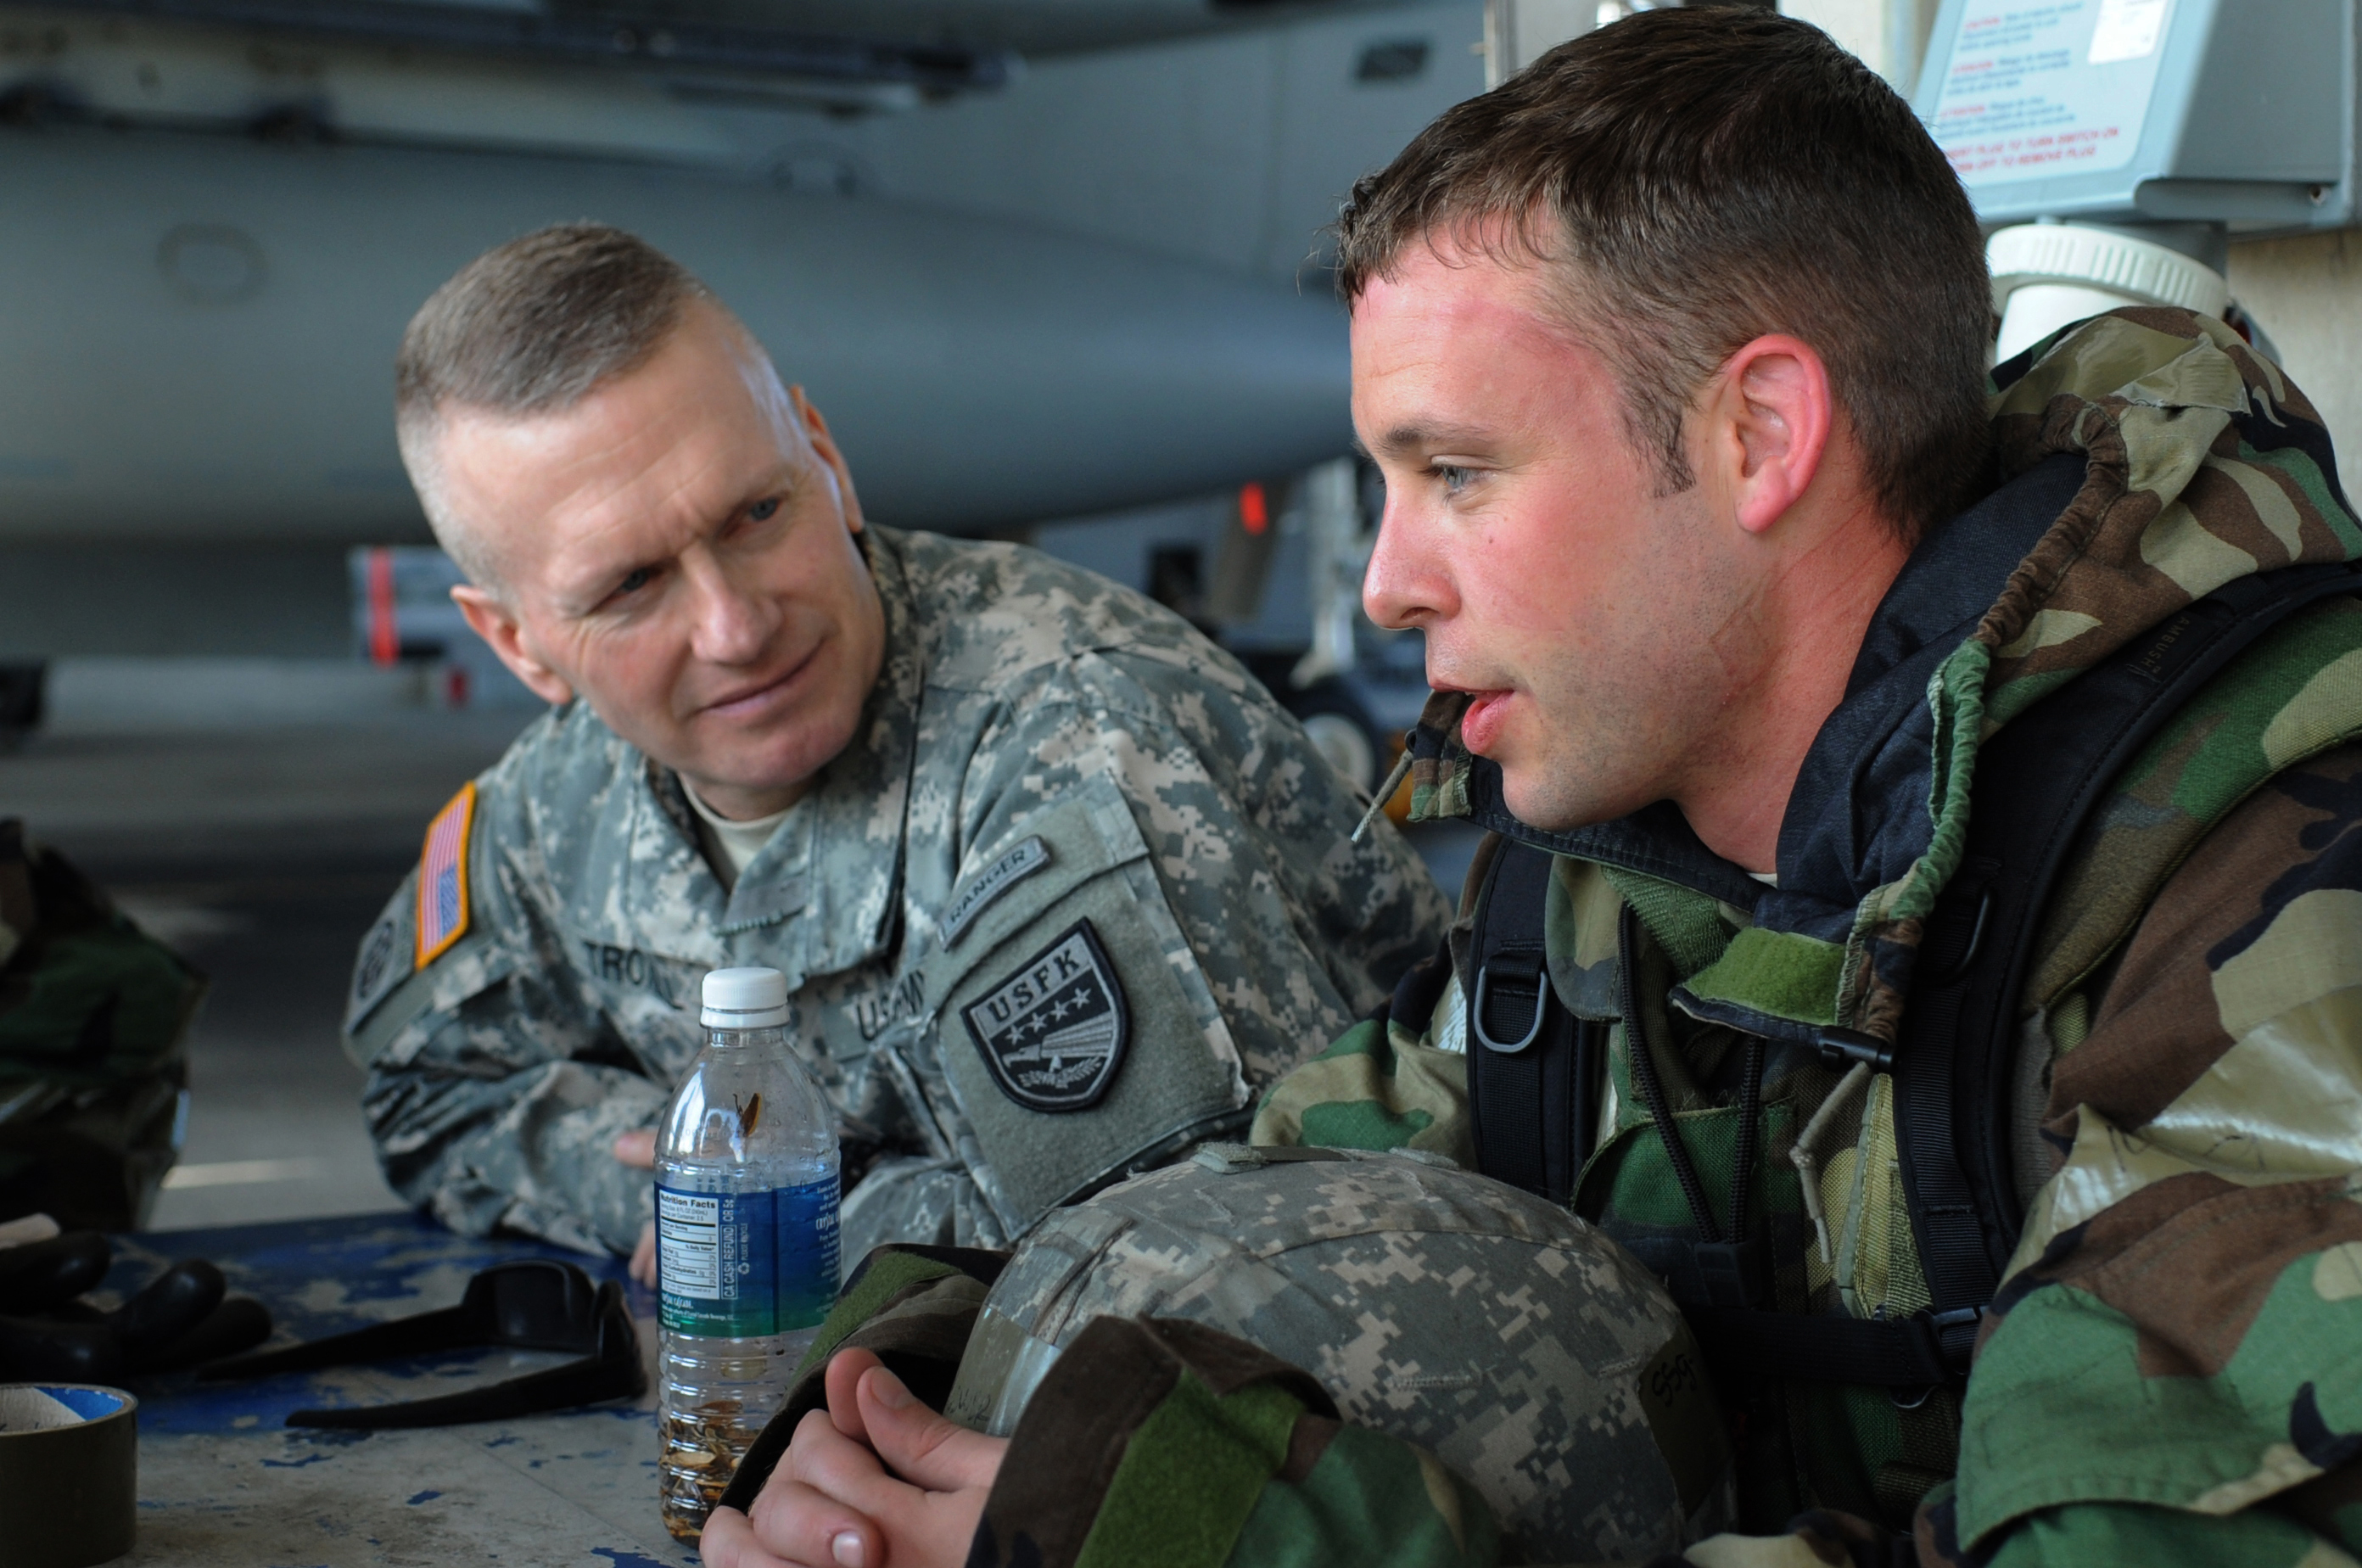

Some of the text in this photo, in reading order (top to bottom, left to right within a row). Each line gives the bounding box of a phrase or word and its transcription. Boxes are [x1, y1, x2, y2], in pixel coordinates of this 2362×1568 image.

[2141, 616, 2190, 667] AMBUSH
[949, 848, 1025, 922] RANGER
[987, 949, 1081, 1022] USFK
[660, 1193, 688, 1207] Nutrition
[691, 1199, 716, 1209] Facts
[722, 1209, 735, 1222] OR
[723, 1227, 735, 1260] REFUND
[724, 1262, 735, 1284] CASH
[724, 1285, 735, 1297] CA
